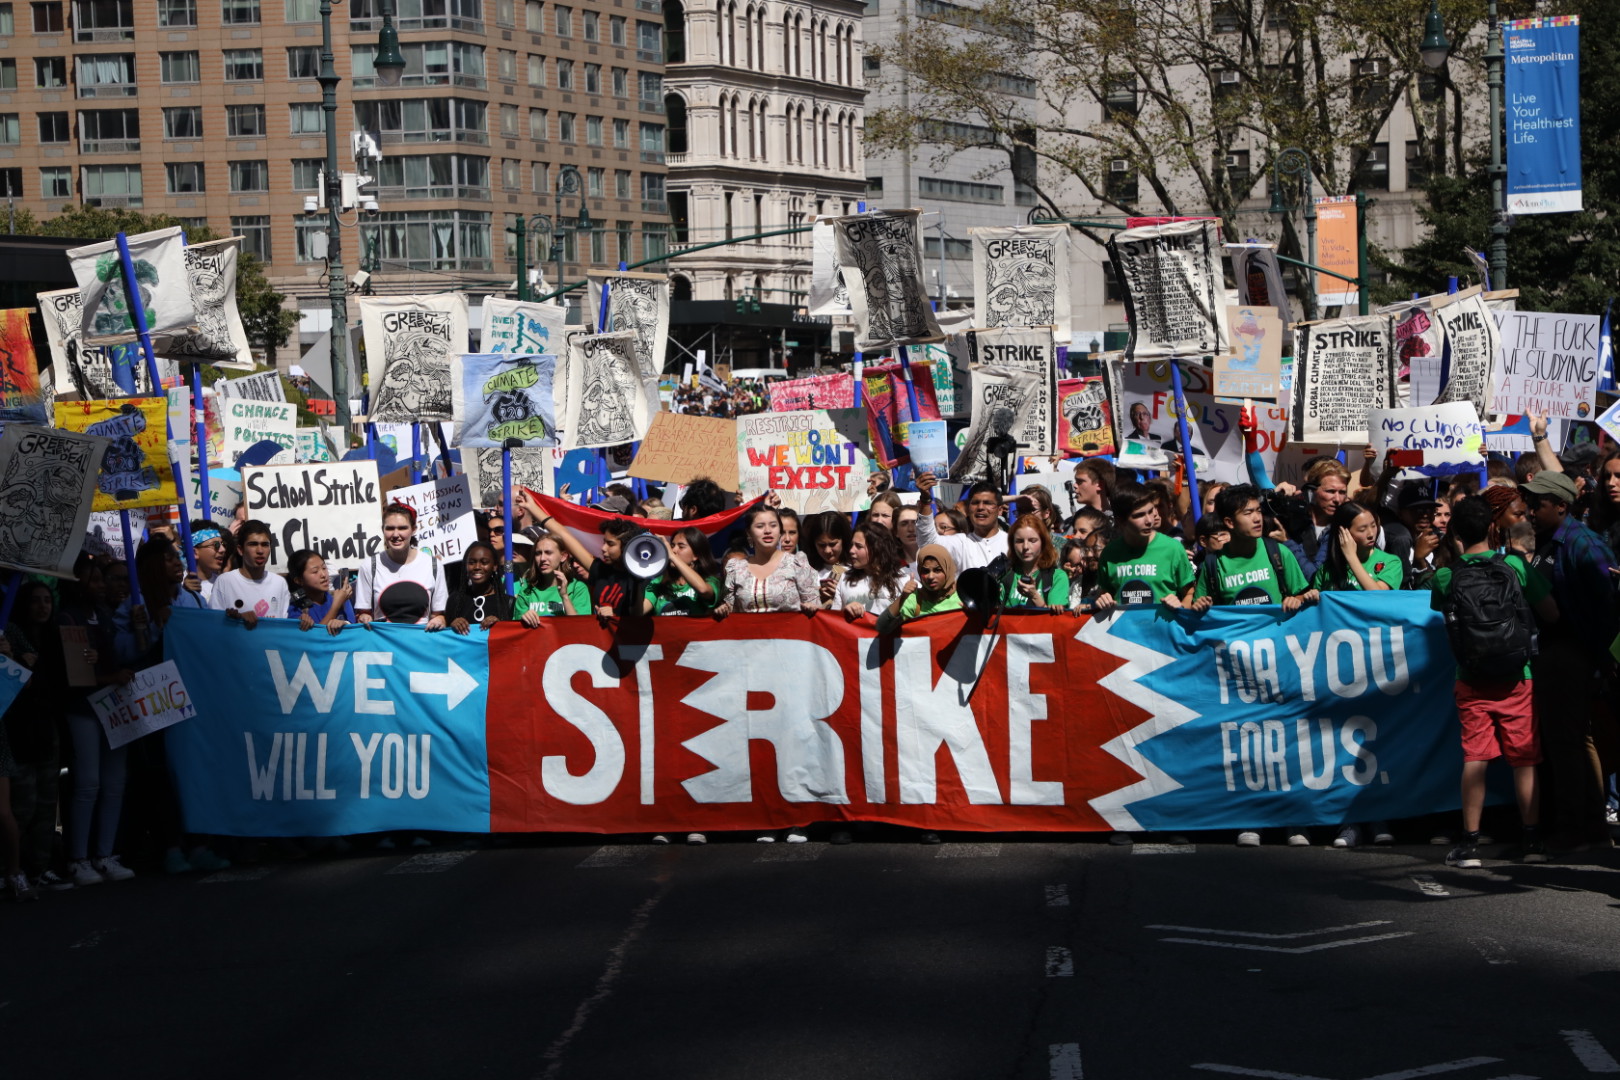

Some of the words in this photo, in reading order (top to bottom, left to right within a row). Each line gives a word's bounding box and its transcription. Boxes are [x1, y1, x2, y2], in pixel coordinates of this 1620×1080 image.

[1511, 52, 1574, 64] Metropolitan
[1512, 93, 1536, 104] Live
[1512, 106, 1540, 117] Your
[1514, 118, 1574, 130] Healthiest
[1514, 132, 1538, 144] Life.
[988, 240, 1040, 259] GREEN
[1010, 244, 1036, 258] NEW
[1124, 234, 1195, 257] STRIKE
[195, 256, 222, 276] DEAL
[1026, 250, 1054, 266] DEAL
[54, 292, 82, 312] GRE
[634, 284, 656, 301] DEAL
[383, 312, 438, 333] GREEN
[408, 318, 434, 332] NEW
[492, 315, 515, 325] RIVER
[1448, 312, 1482, 338] STRIKE
[424, 324, 451, 342] DEAL
[491, 330, 514, 339] RIVER
[1315, 331, 1382, 350] STRIKE
[1513, 314, 1545, 349] THE
[1554, 318, 1596, 351] FUCK
[983, 345, 1044, 361] STRIKE
[1311, 350, 1320, 384] CLIMATE
[1502, 348, 1522, 375] WE
[1526, 350, 1596, 383] STUDYING
[235, 370, 282, 402] WANT
[487, 366, 538, 390] CLIMATE
[1219, 380, 1273, 394] EARTH
[1501, 376, 1510, 392] A
[1524, 379, 1564, 398] FUTURE
[1574, 384, 1590, 400] WE
[1065, 388, 1106, 407] CLIMATE
[1310, 386, 1318, 418] GLOBAL
[1518, 396, 1542, 416] EVEN
[1548, 400, 1573, 416] HAVE
[1152, 391, 1229, 434] FOOLS
[89, 412, 145, 436] CLIMATE
[490, 422, 539, 440] STRIKE
[745, 415, 813, 435] RESTRICT
[1382, 418, 1404, 432] No
[18, 434, 80, 454] GREEN
[234, 426, 295, 450] POLITICS
[787, 428, 840, 447] BEFORE
[1072, 428, 1109, 445] STRIKE
[1404, 434, 1463, 449] Change
[43, 444, 74, 457] NEW
[636, 454, 663, 466] WE
[746, 444, 789, 466] WE
[60, 452, 88, 474] DEAL
[102, 468, 153, 490] STRIKE
[768, 466, 851, 490] EXIST
[248, 470, 314, 510] School
[314, 468, 377, 506] Strike
[423, 484, 463, 502] MISSING
[417, 498, 462, 517] LESSONS
[418, 520, 425, 530] I
[428, 513, 450, 526] CAN
[441, 523, 457, 534] YOU
[282, 518, 382, 560] Climate
[1117, 565, 1133, 578] NYC
[1134, 564, 1157, 577] CORE
[1225, 574, 1244, 588] NYC
[1246, 568, 1270, 583] CORE
[529, 601, 546, 612] NYC
[1212, 637, 1284, 705] FOR
[264, 649, 396, 715] WE
[96, 688, 124, 711] THE
[542, 632, 1066, 806] STRIKE
[1220, 720, 1290, 792] FOR
[1296, 715, 1390, 791] US.
[244, 732, 336, 801] WILL
[350, 732, 431, 800] YOU
